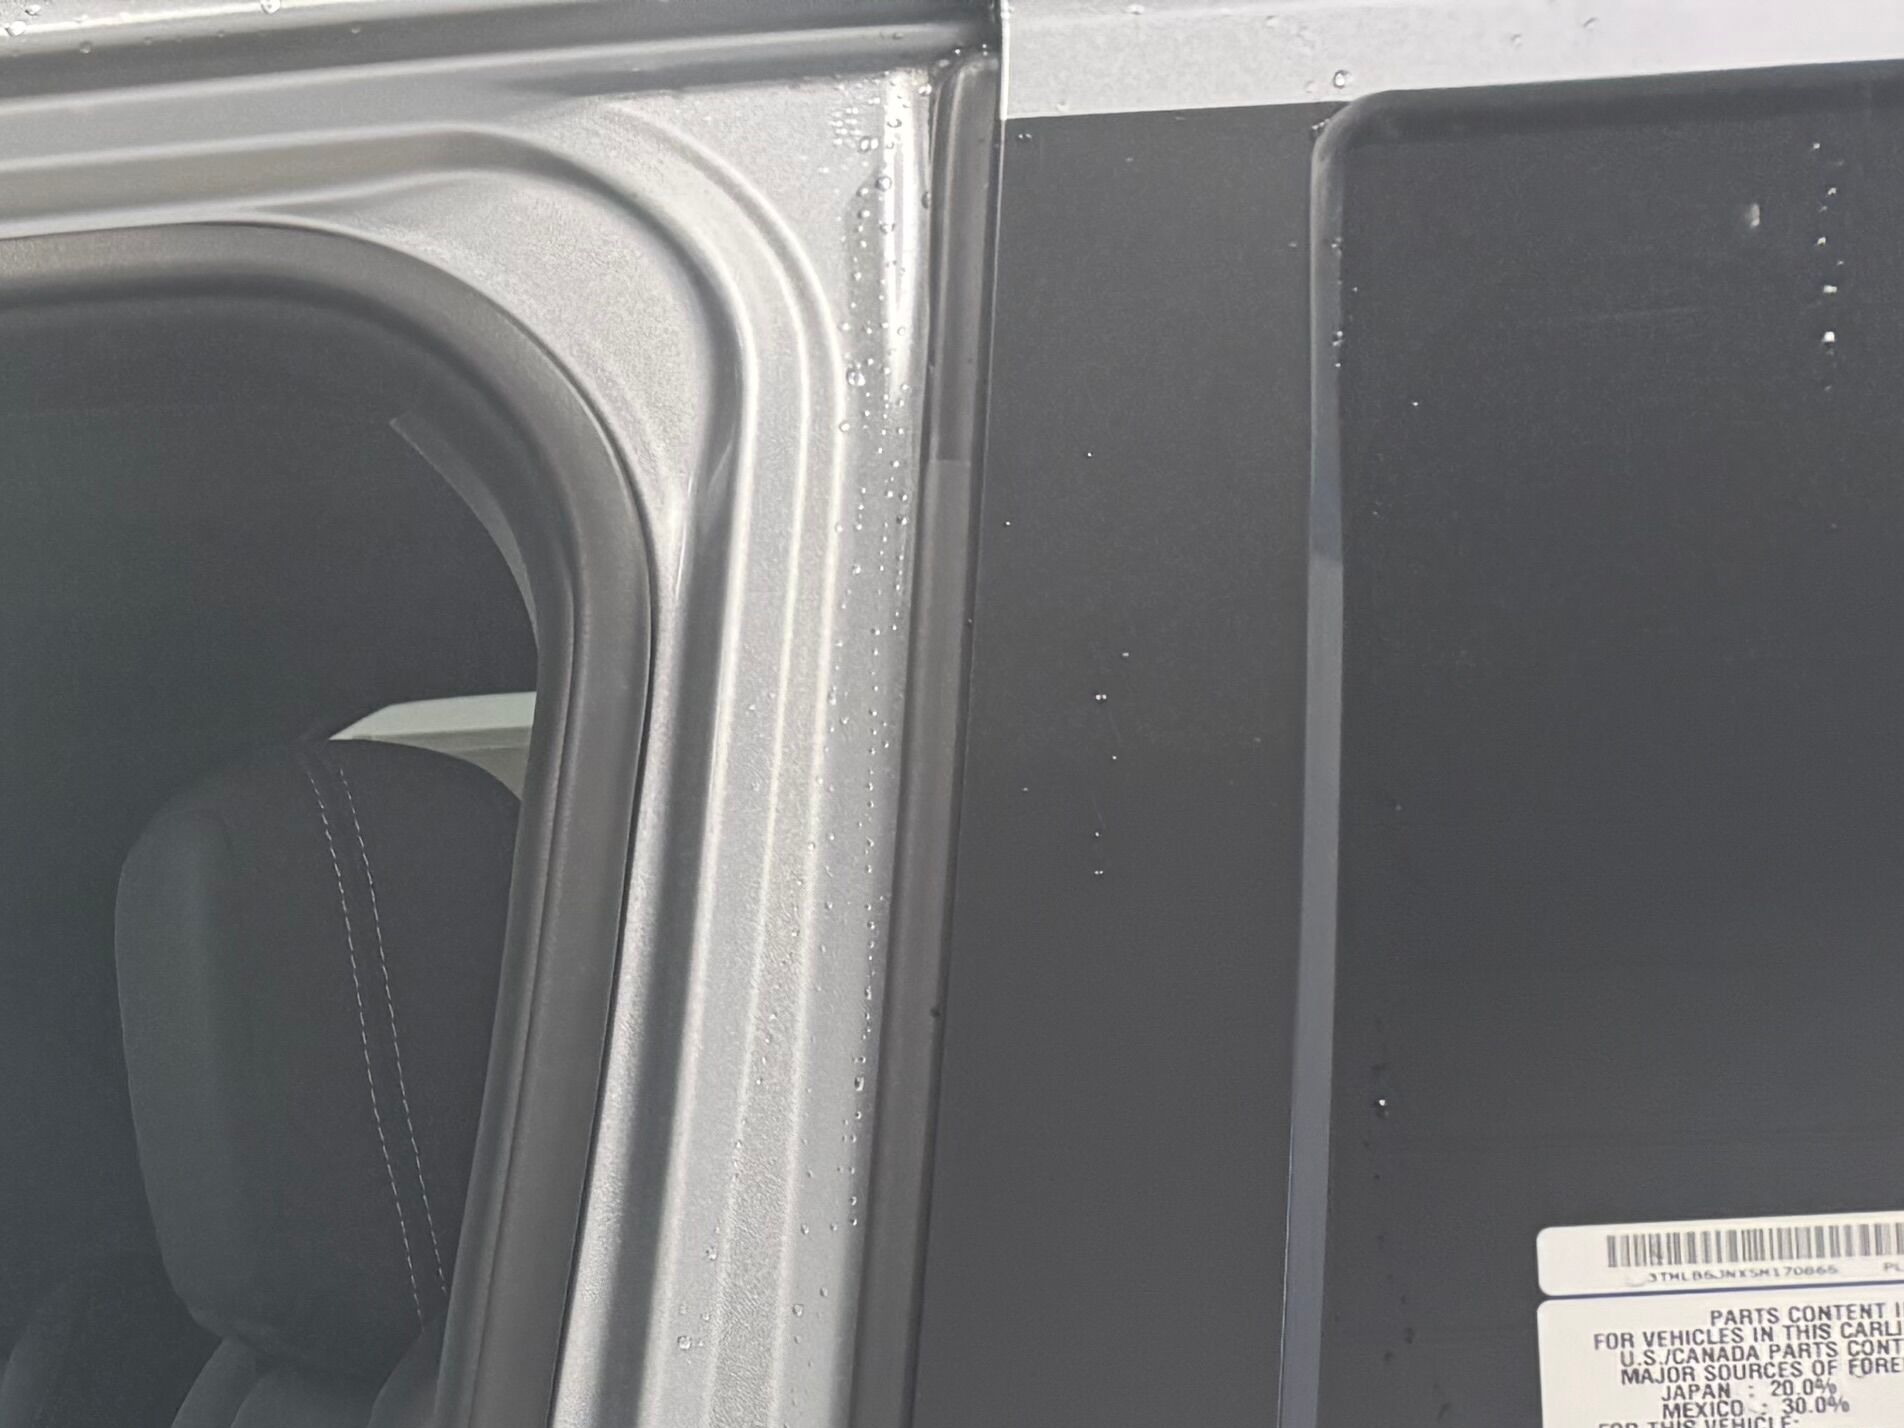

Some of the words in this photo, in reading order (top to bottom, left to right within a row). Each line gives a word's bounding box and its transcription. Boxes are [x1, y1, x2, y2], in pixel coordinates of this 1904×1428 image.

[1710, 1307, 1780, 1327] PARTS
[1788, 1302, 1886, 1324] CONTENT
[1594, 1332, 1636, 1351] FOR
[1643, 1327, 1744, 1349] VEHICLES
[1753, 1324, 1775, 1343] IN
[1783, 1321, 1833, 1342] THIS
[1620, 1345, 1761, 1367] U.S./CANADA
[1769, 1341, 1840, 1360] PARTS
[1847, 1338, 1904, 1358] CONT
[1621, 1365, 1696, 1386] MAJOR
[1704, 1360, 1804, 1382] SOURCES
[1812, 1358, 1839, 1378] OF
[1661, 1382, 1731, 1403] JAPAN
[1770, 1379, 1838, 1398] 20.0%
[1662, 1399, 1743, 1421] MEXICO
[1782, 1396, 1851, 1415] 30.0%
